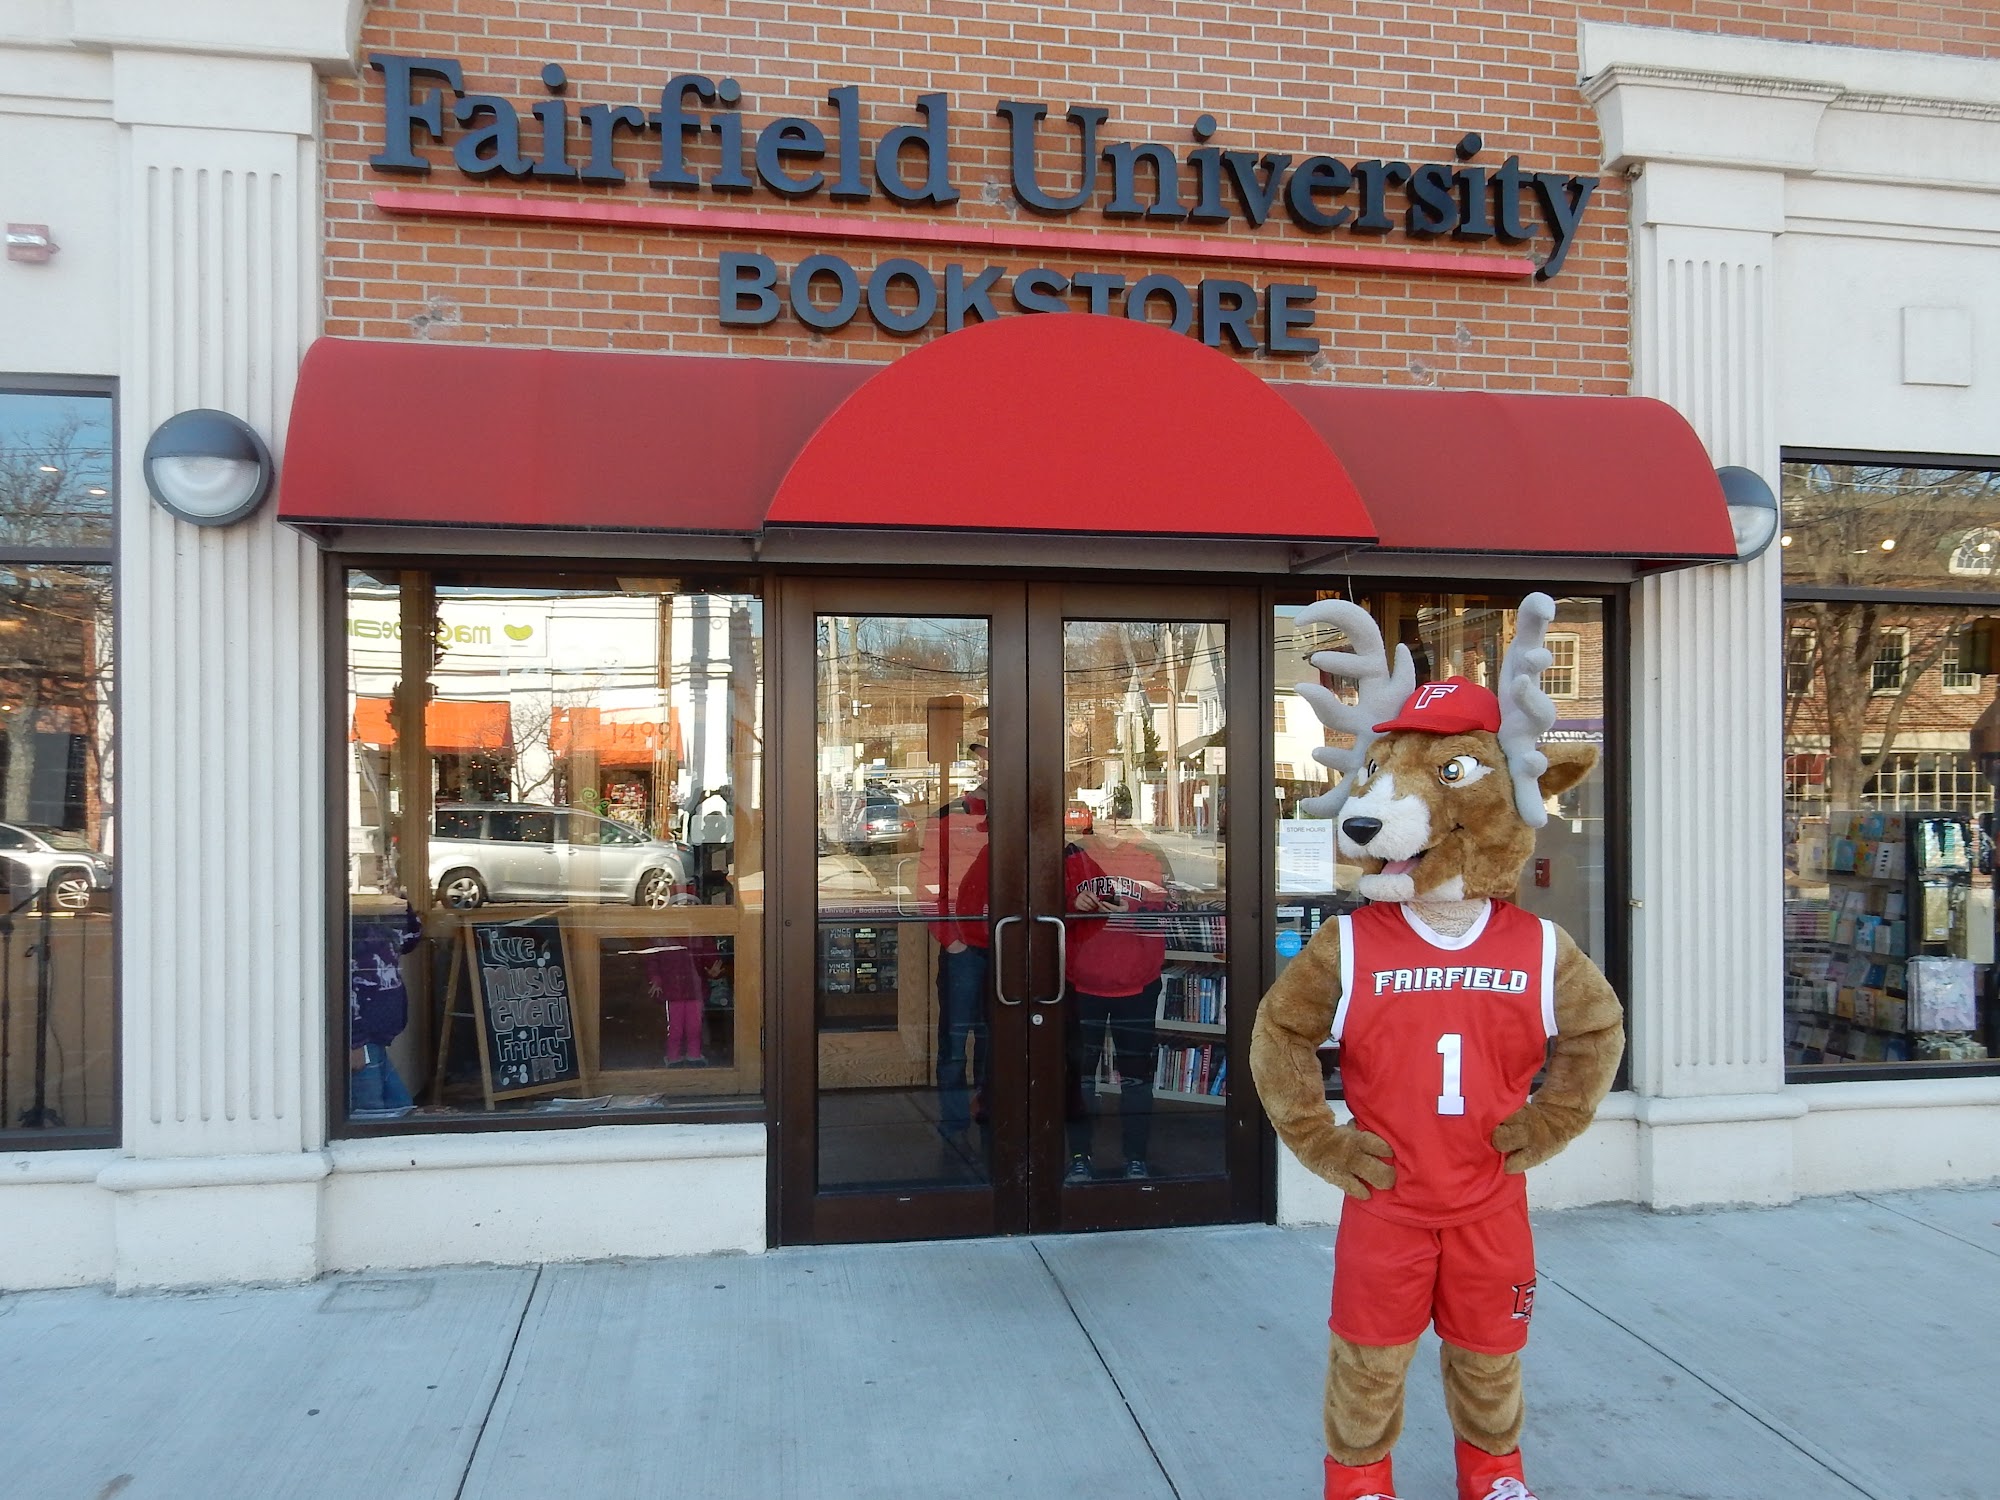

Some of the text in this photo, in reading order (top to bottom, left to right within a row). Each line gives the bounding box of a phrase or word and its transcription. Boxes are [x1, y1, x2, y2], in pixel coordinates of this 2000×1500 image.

[369, 53, 1599, 282] Fairfield University
[718, 251, 1320, 355] BOOKSTORE
[1414, 684, 1459, 710] F
[609, 721, 671, 745] 1499
[477, 928, 537, 968] Live
[1371, 966, 1528, 996] FAIRFIELD
[491, 997, 571, 1042] every
[496, 1026, 569, 1073] Friday
[1436, 1033, 1465, 1115] 1
